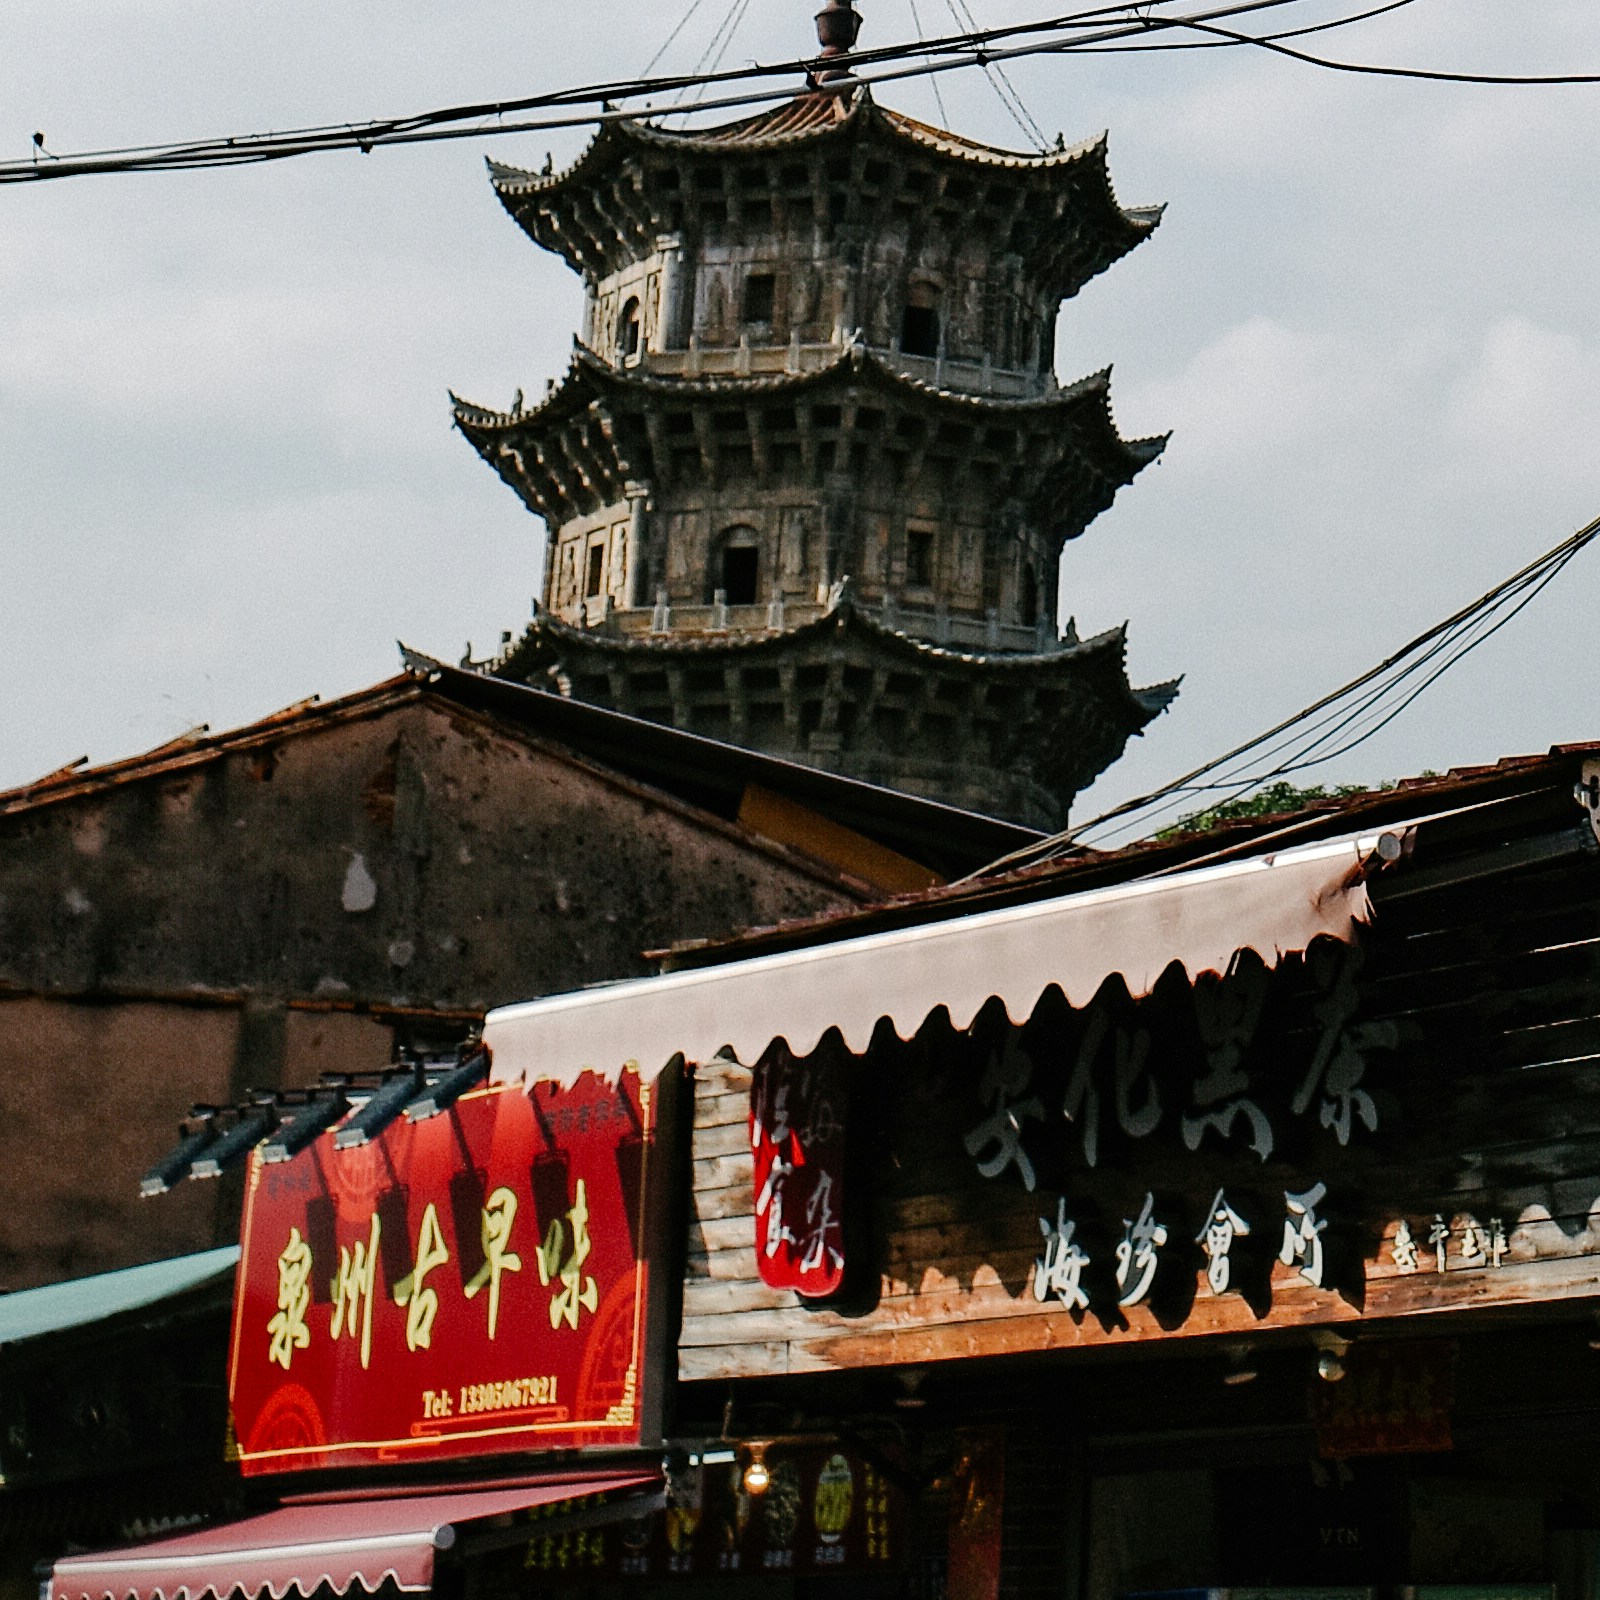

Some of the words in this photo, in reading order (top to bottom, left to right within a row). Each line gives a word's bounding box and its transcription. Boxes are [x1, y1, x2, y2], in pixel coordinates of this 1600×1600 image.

[267, 1179, 598, 1369] 泉州古早味
[422, 1389, 453, 1418] Tel:
